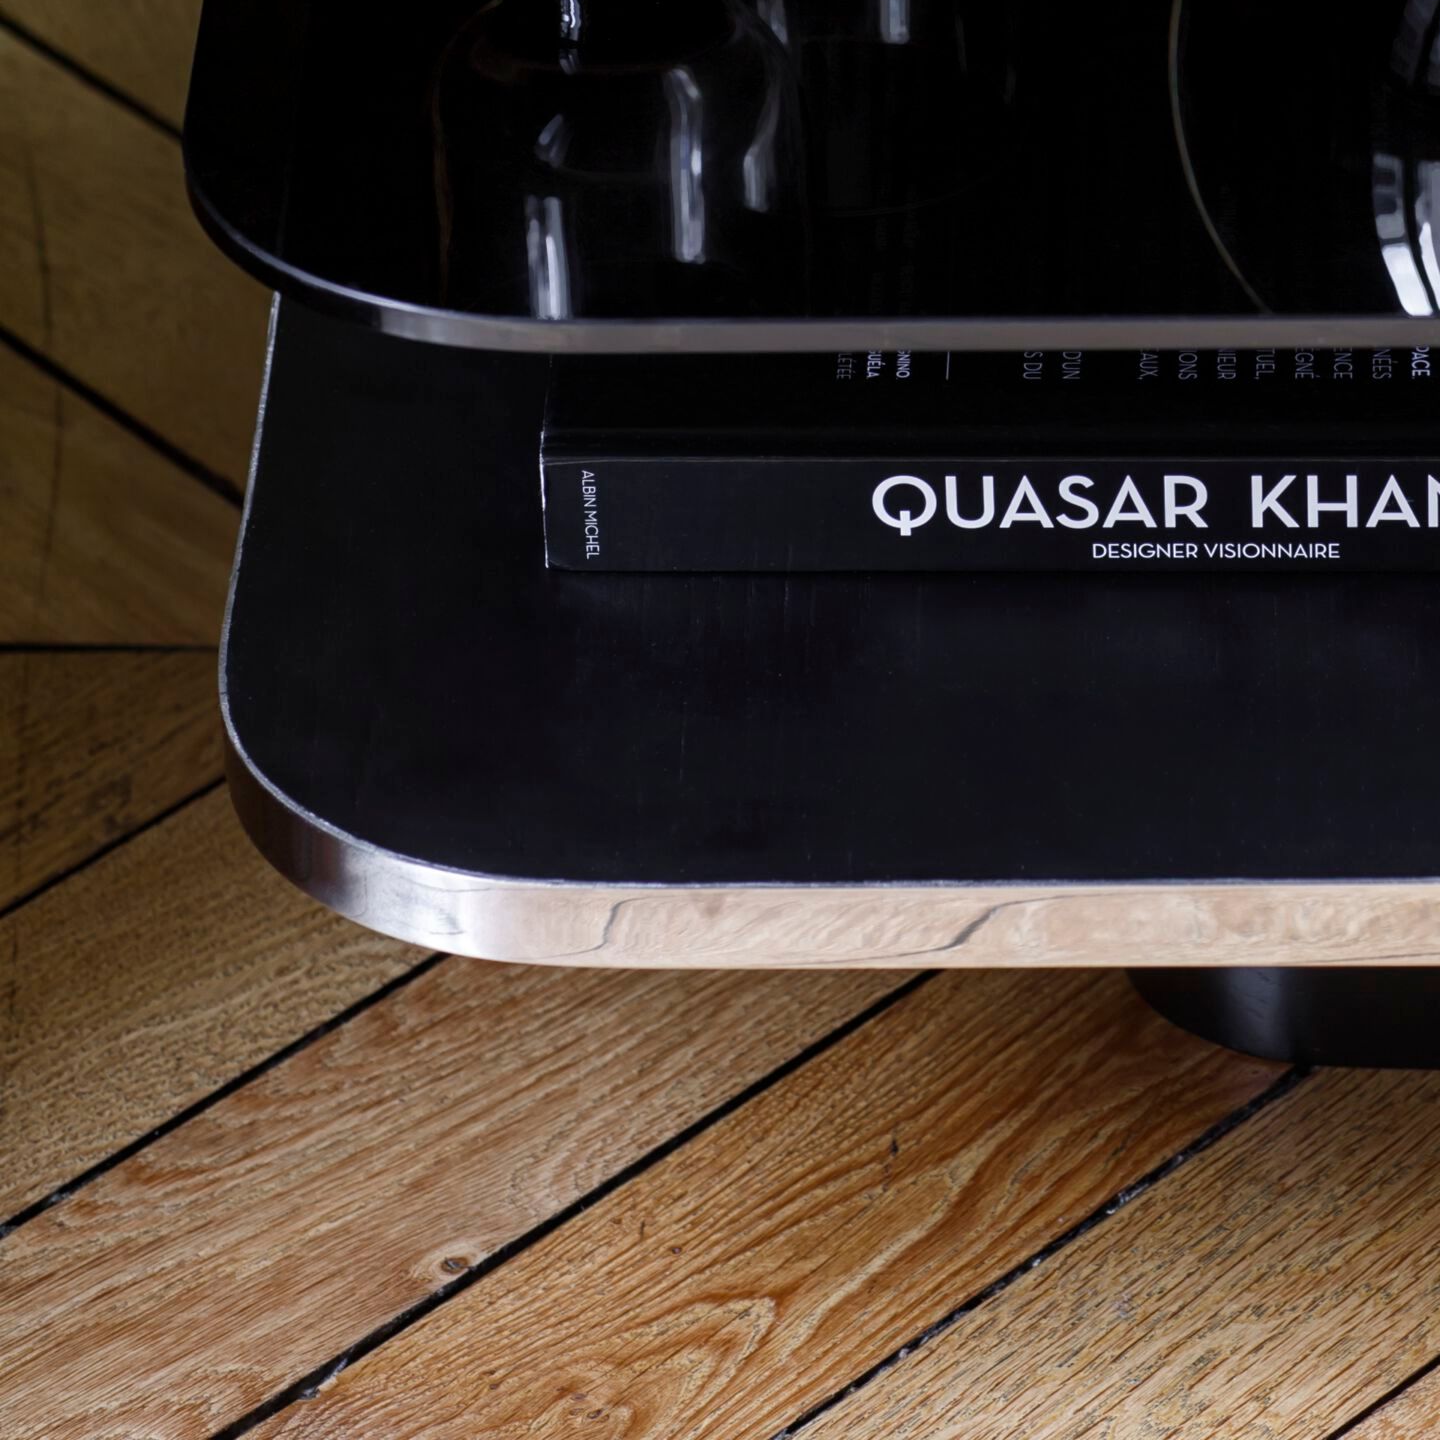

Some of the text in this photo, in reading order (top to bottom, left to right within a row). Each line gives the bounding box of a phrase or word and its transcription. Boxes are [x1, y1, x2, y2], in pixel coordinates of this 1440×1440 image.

[1023, 362, 1044, 380] DU
[582, 469, 600, 560] ALBIN MICHEL
[871, 474, 1209, 536] QUASAR
[1091, 543, 1341, 559] DESIGNER VISIONNAIRE
